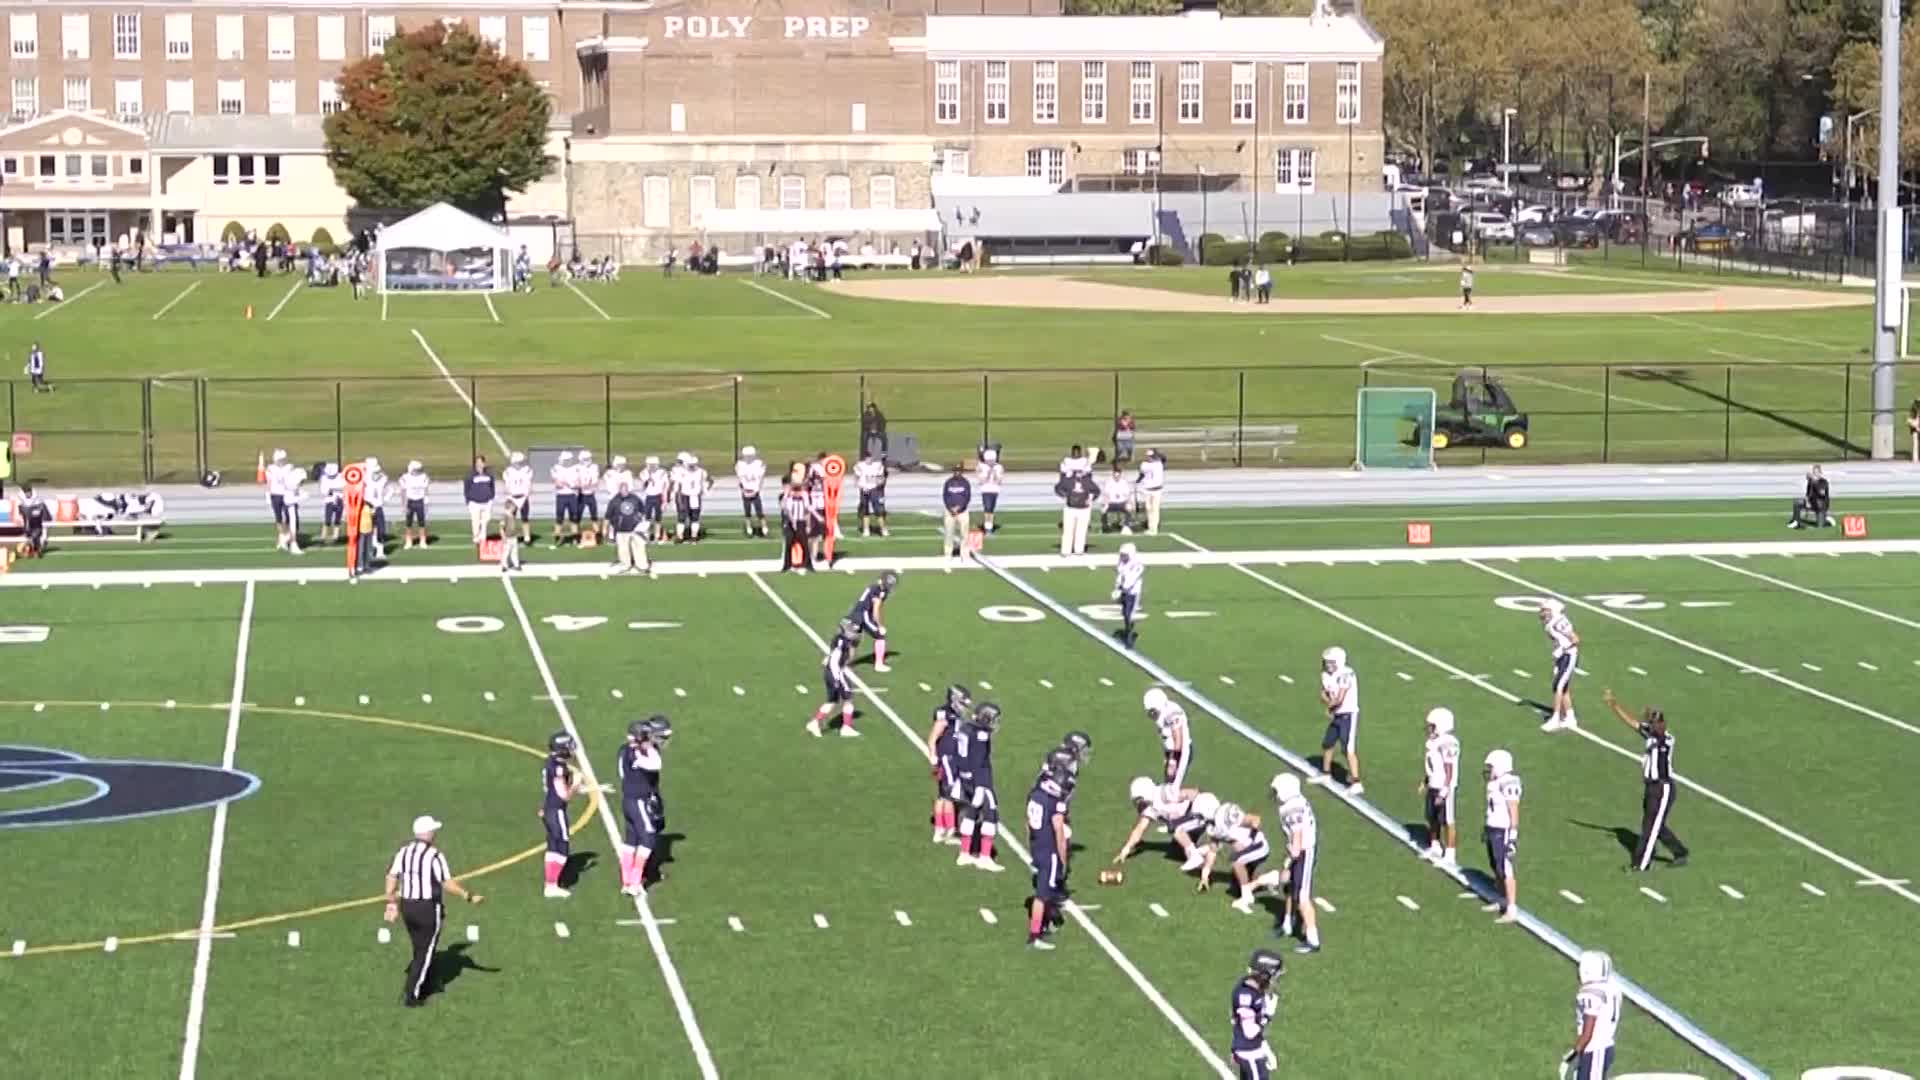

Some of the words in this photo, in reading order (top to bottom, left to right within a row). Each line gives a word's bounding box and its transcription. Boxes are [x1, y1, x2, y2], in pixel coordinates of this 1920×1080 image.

[663, 16, 752, 38] POLY
[784, 16, 870, 38] PREP
[436, 614, 609, 633] 40
